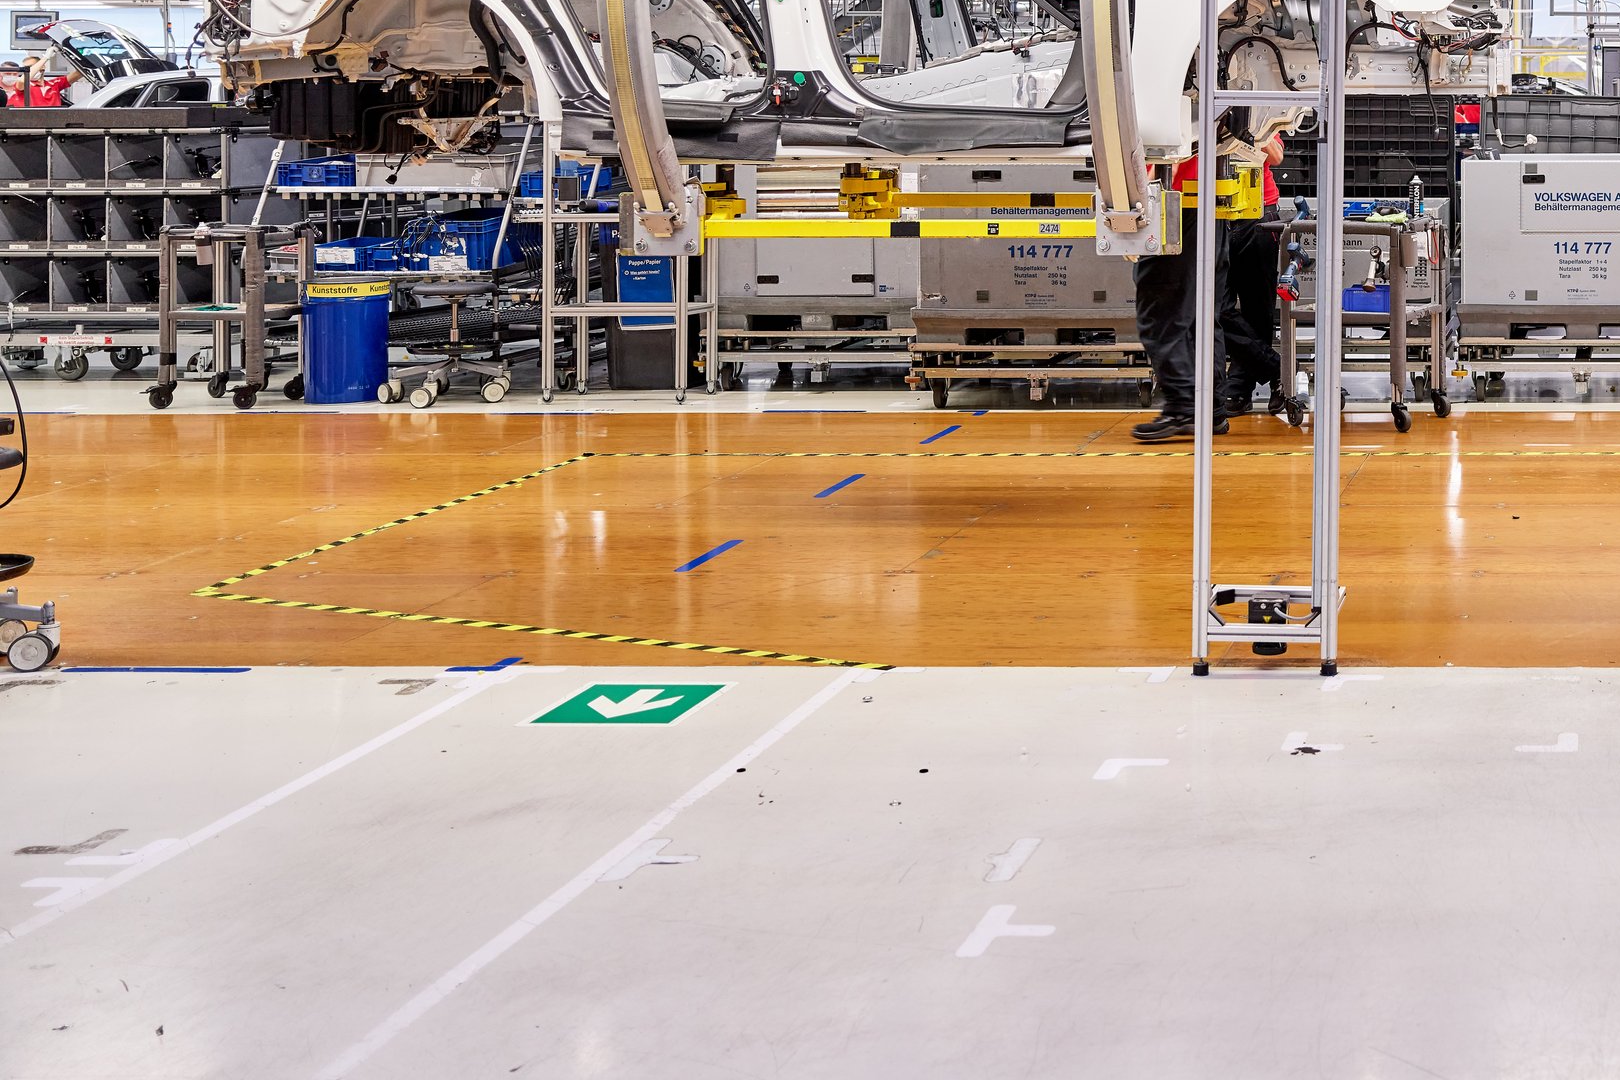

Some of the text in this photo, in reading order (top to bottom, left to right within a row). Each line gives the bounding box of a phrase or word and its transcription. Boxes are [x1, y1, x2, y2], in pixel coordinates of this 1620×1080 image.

[1534, 192, 1612, 202] VOLKSWAGEN
[990, 207, 1090, 217] Behältermanagement
[1040, 223, 1060, 233] 2474
[1303, 238, 1310, 246] &
[1007, 245, 1073, 258] 114 777
[1553, 242, 1612, 254] 114 777
[312, 286, 358, 294] Kunststoffe
